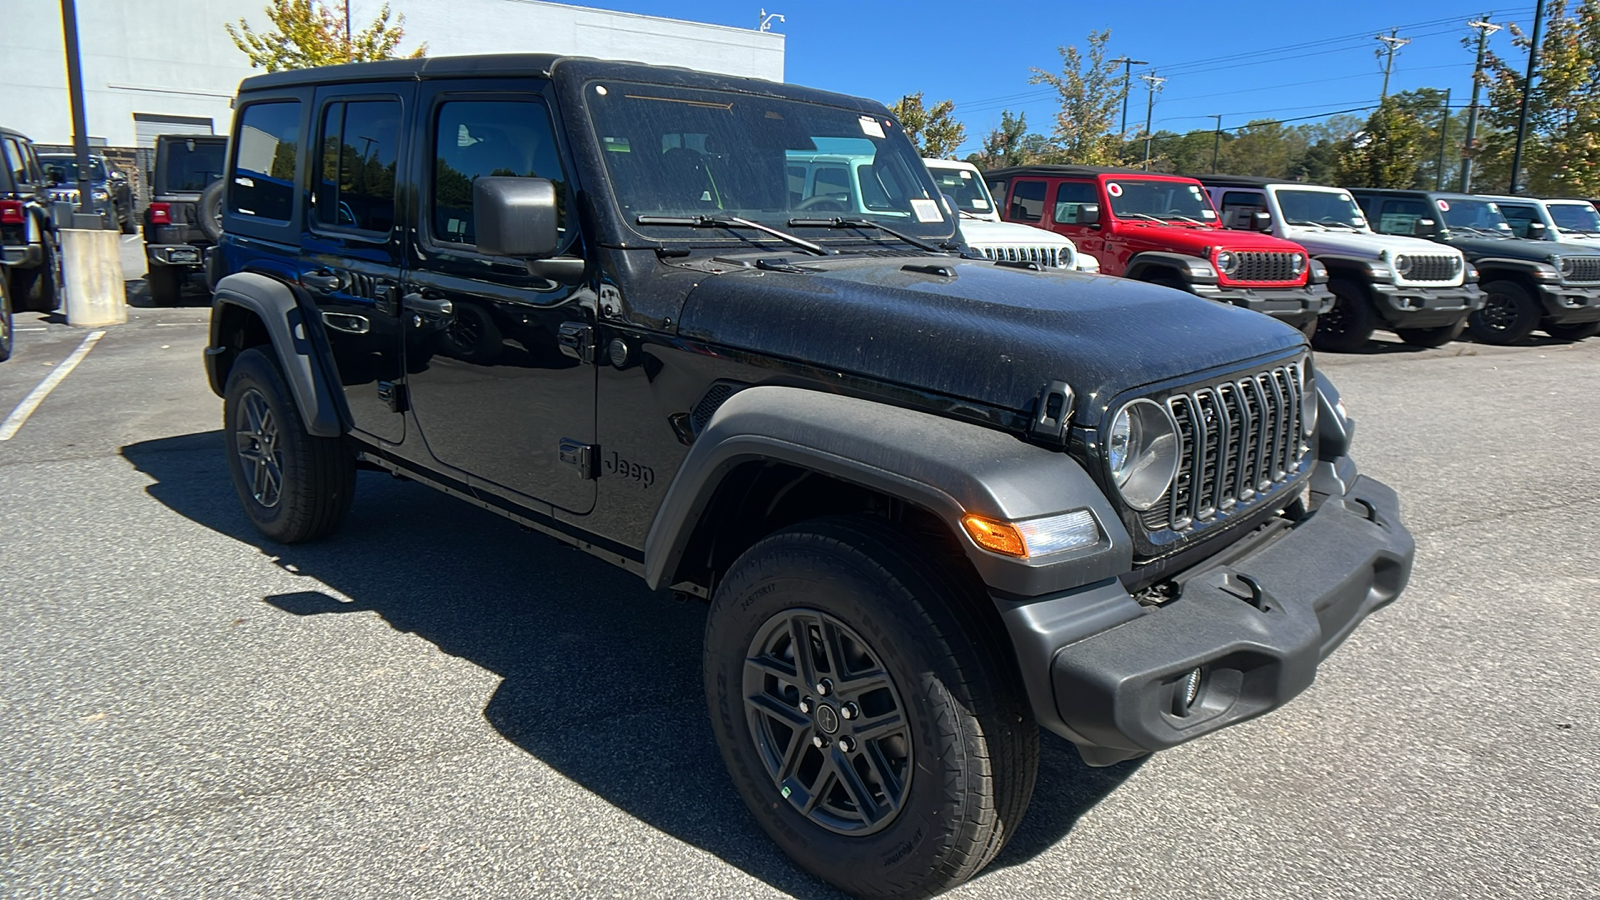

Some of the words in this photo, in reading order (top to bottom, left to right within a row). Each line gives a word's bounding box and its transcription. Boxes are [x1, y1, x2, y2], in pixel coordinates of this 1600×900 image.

[604, 451, 655, 489] Jeep
[740, 583, 777, 612] 245/75R17
[861, 614, 932, 748] NEXEN
